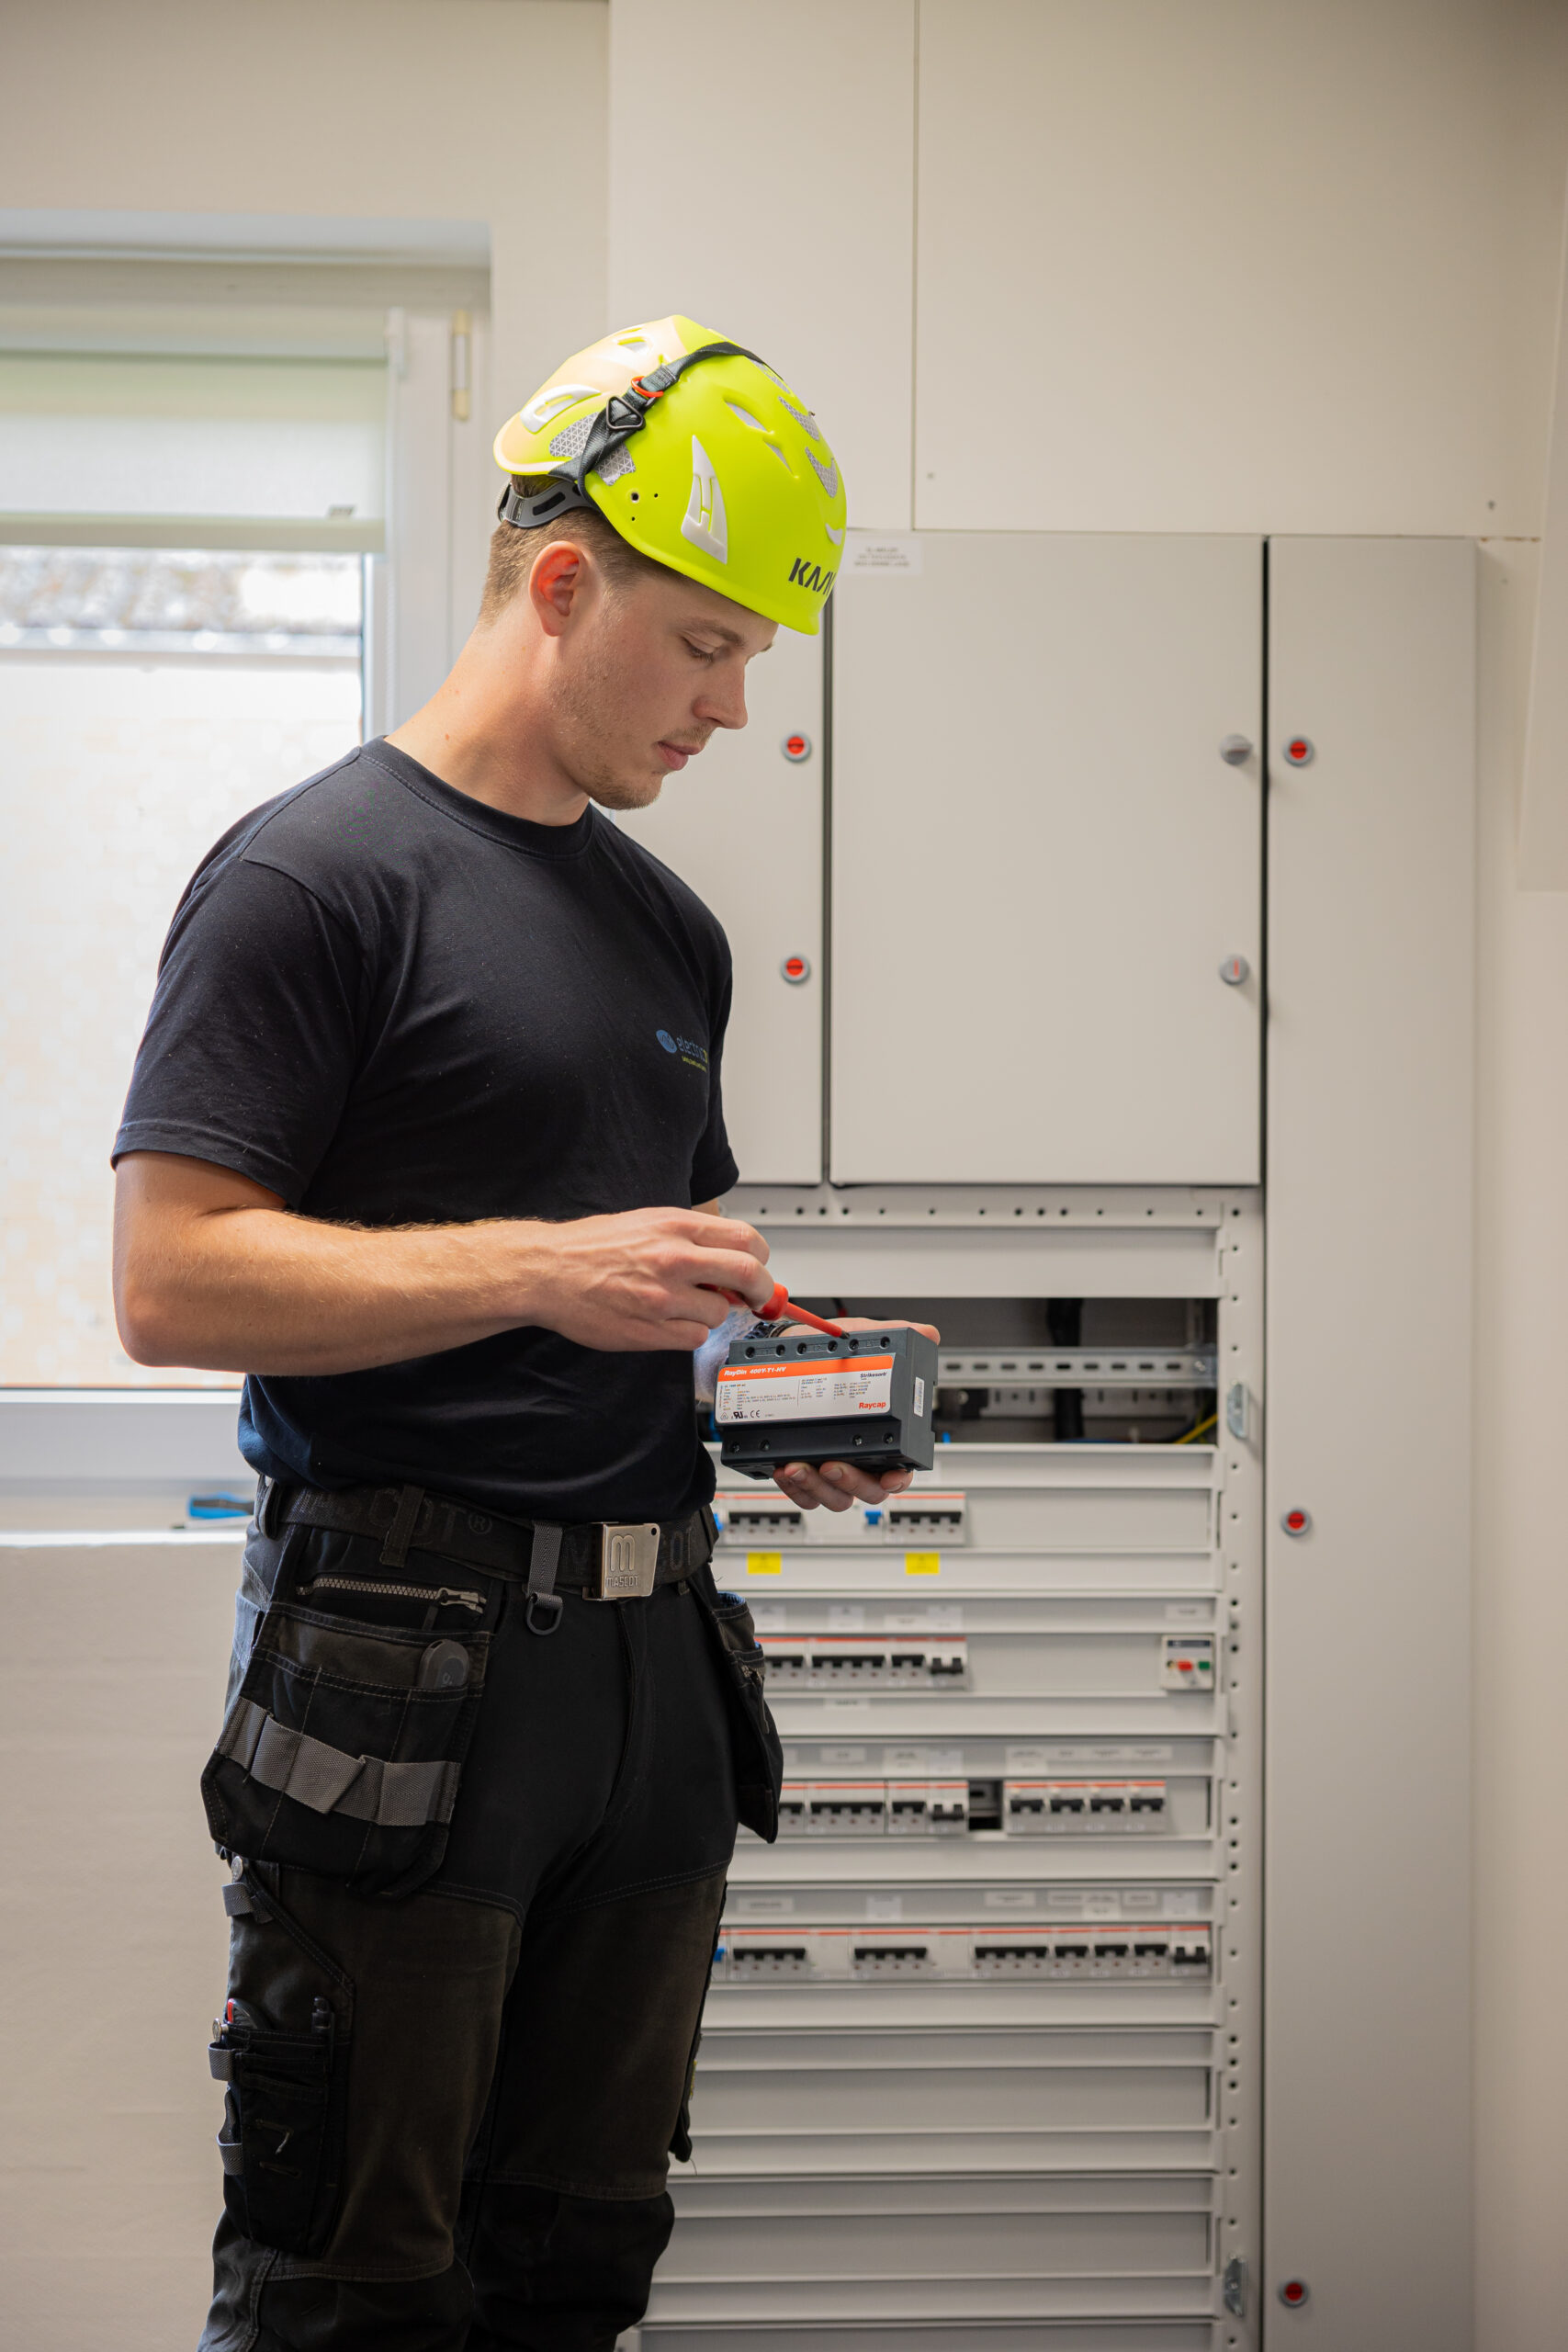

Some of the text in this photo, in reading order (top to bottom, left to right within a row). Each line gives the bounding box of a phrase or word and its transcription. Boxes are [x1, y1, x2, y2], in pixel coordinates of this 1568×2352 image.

[724, 1369, 747, 1377] RayDin
[858, 1402, 886, 1410] Raycap
[606, 1576, 639, 1589] MASCOT
